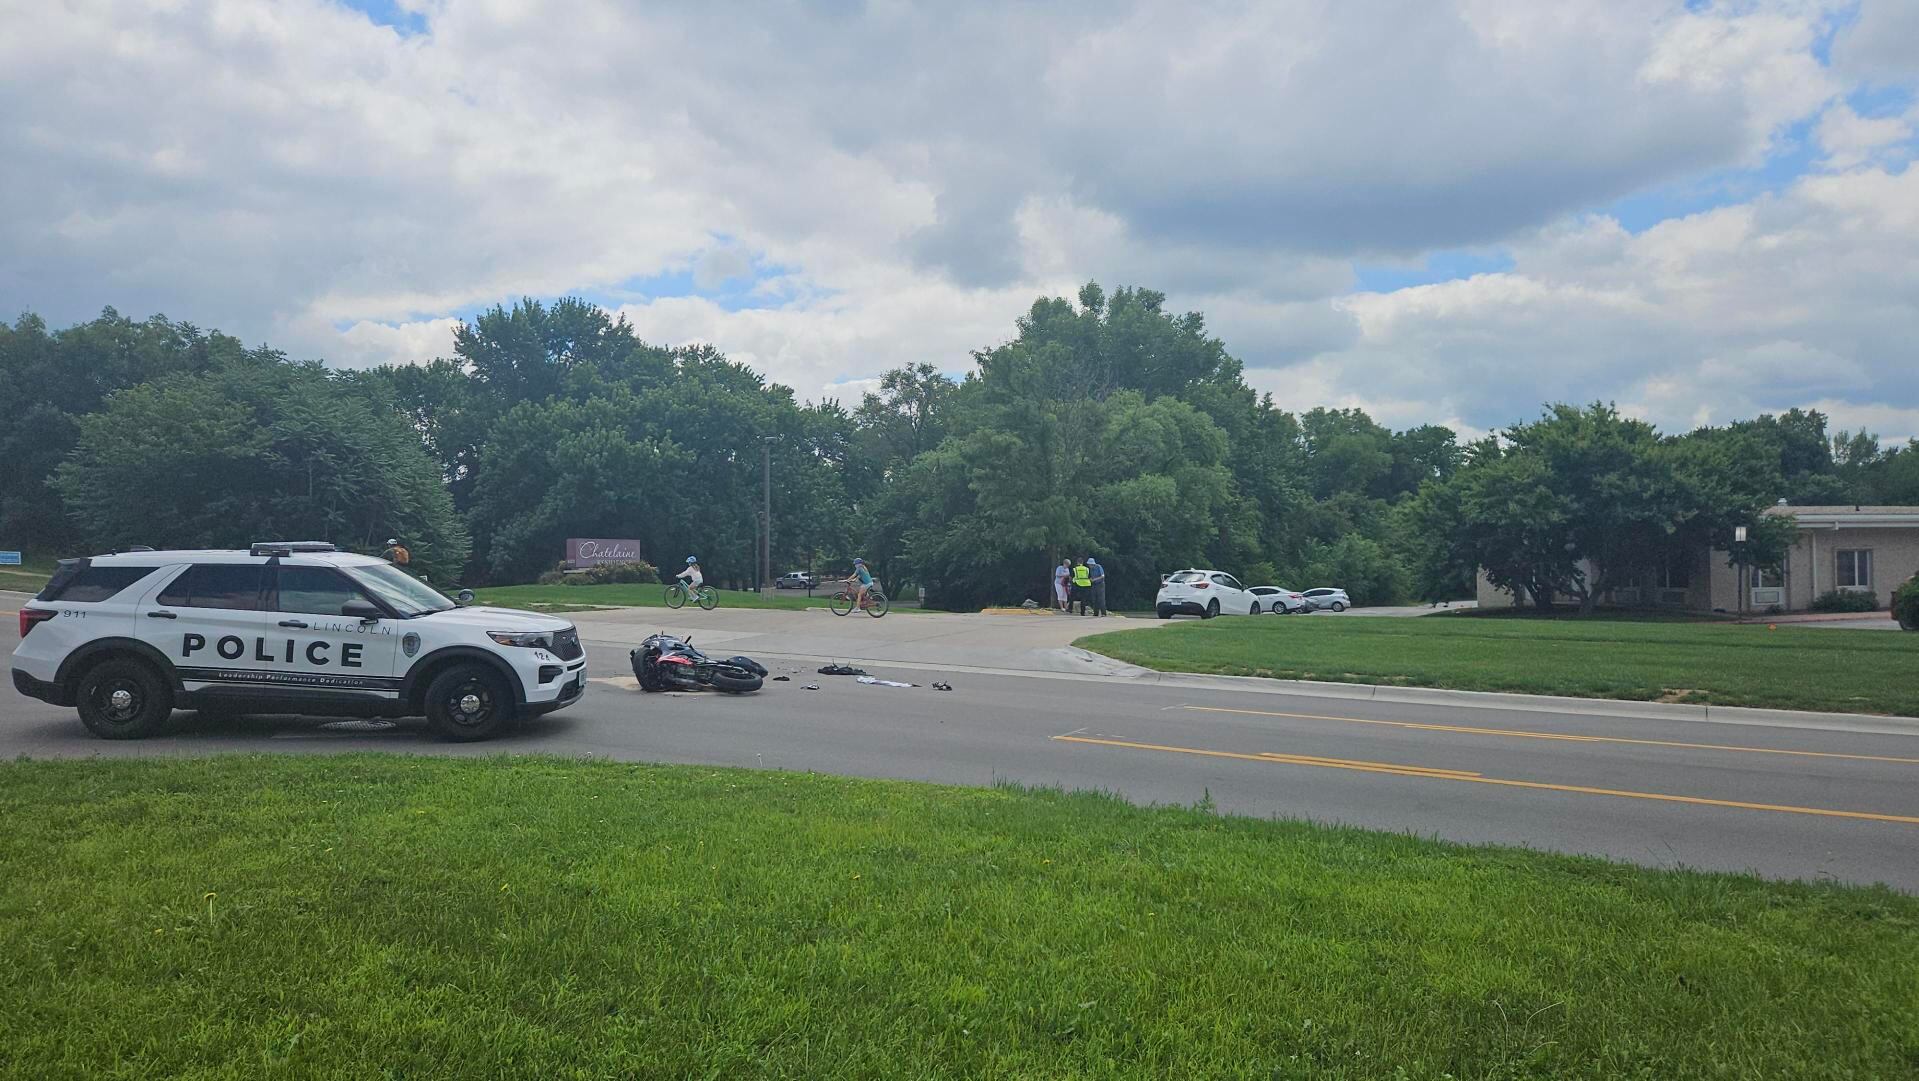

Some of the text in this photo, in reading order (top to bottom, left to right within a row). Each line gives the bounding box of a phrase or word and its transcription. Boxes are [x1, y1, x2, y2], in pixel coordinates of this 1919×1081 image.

[580, 541, 636, 558] Chatelaine
[63, 609, 87, 618] 911
[313, 622, 391, 635] LINCOLN
[182, 633, 363, 668] POLICE
[218, 672, 363, 685] Leadership Performance Dedication
